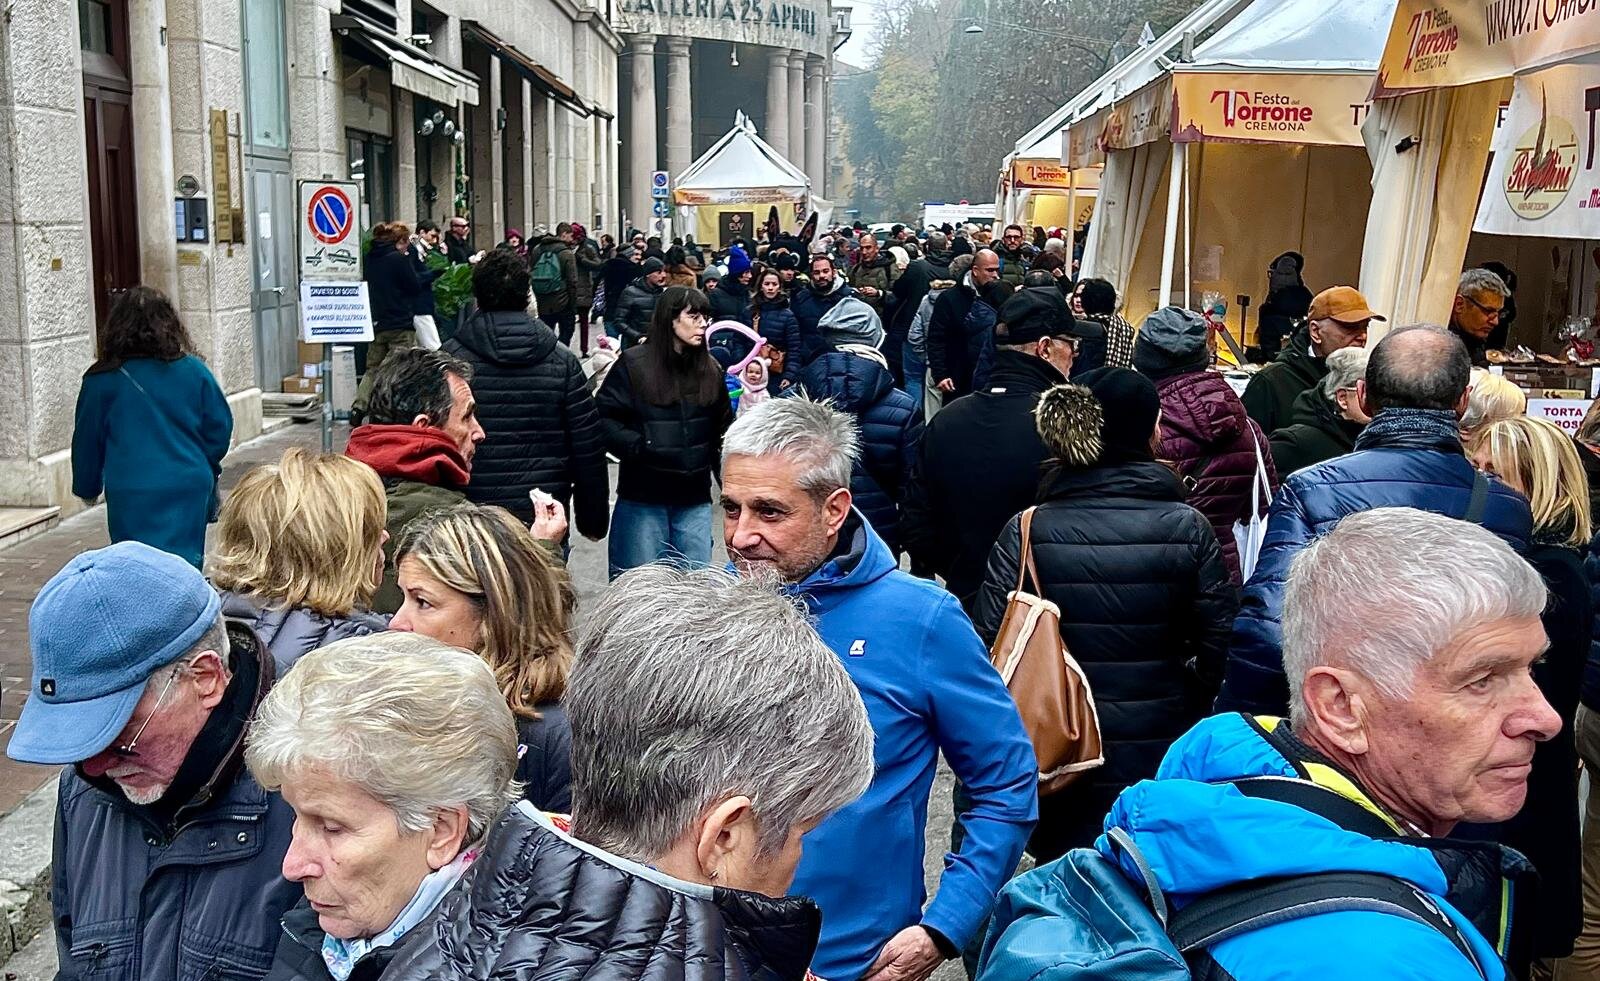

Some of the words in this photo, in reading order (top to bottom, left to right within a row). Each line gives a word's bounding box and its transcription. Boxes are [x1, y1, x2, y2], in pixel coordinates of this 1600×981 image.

[1403, 10, 1459, 72] Torrone
[1254, 92, 1290, 105] Festa
[1210, 90, 1313, 128] Torrone
[1245, 121, 1305, 132] CREMONA
[1543, 407, 1583, 417] TORTA
